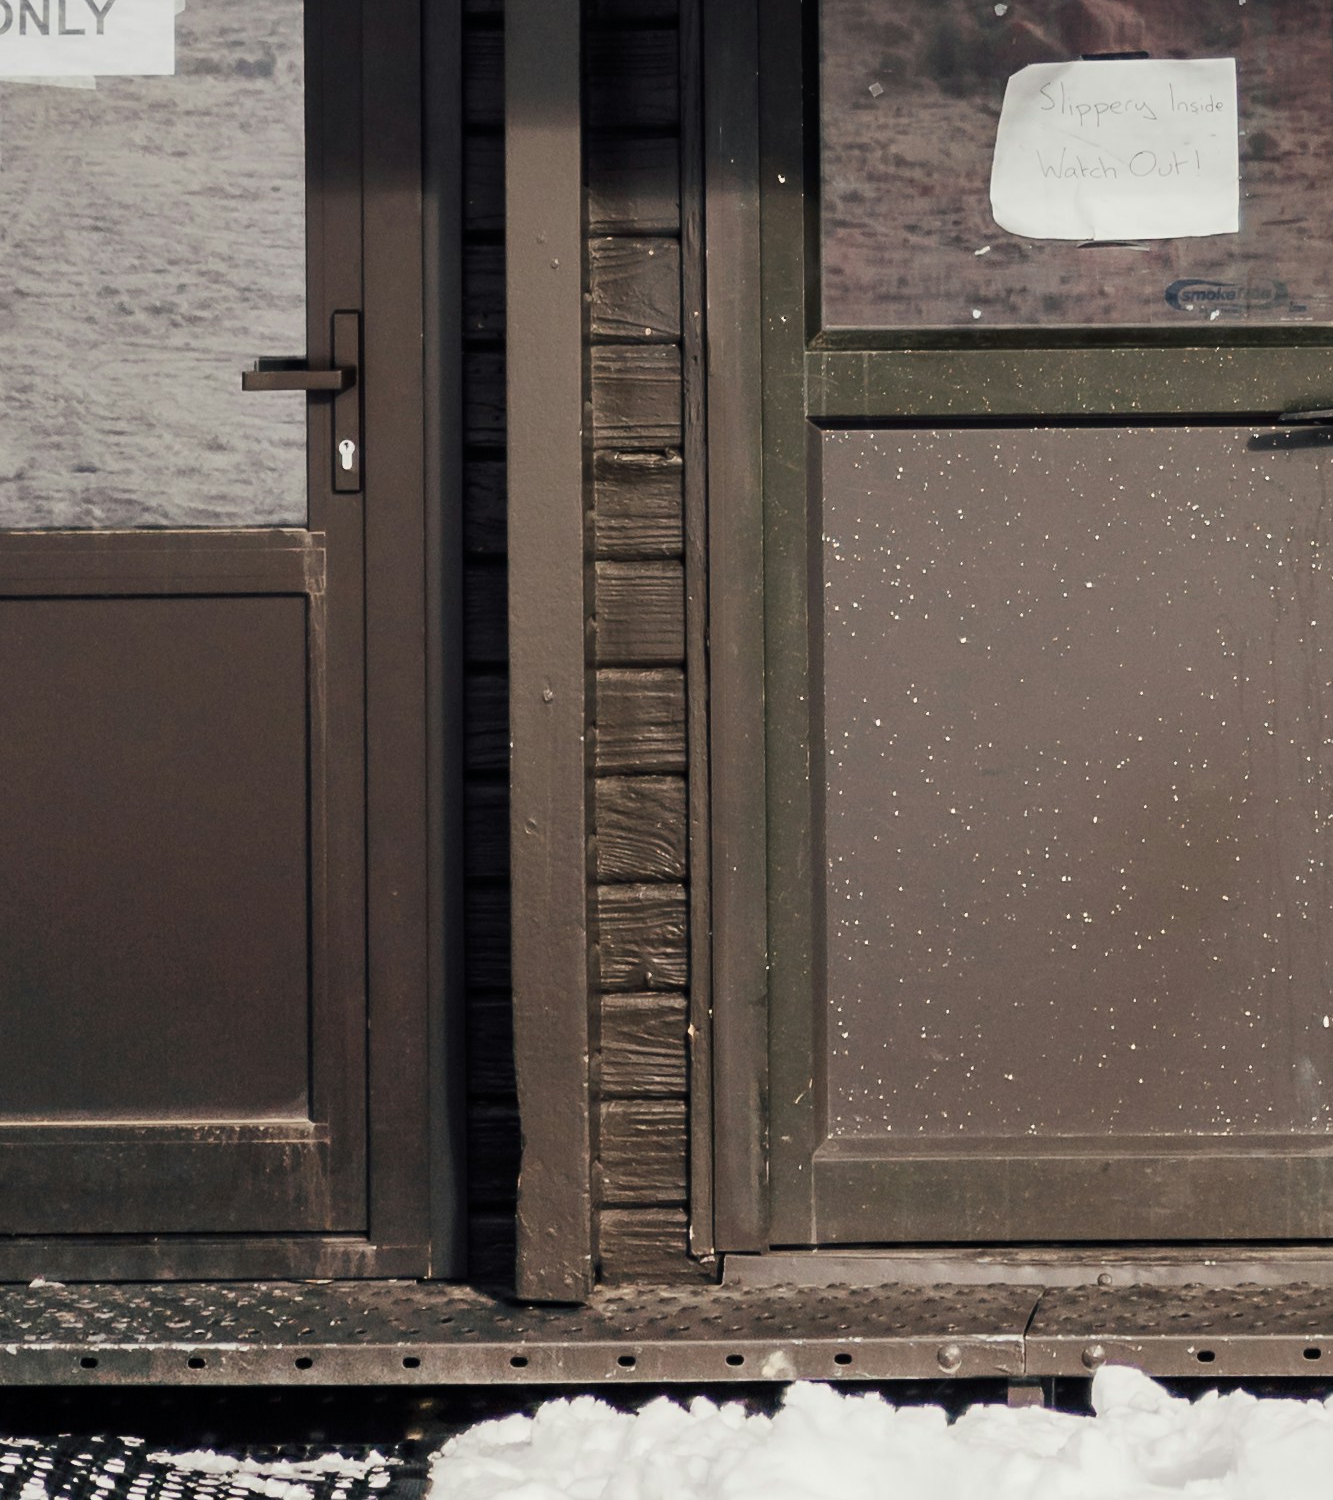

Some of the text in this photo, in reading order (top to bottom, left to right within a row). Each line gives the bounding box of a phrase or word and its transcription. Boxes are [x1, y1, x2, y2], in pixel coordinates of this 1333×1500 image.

[1039, 81, 1225, 128] Slippery Inside
[1035, 146, 1202, 181] Watch Out!
